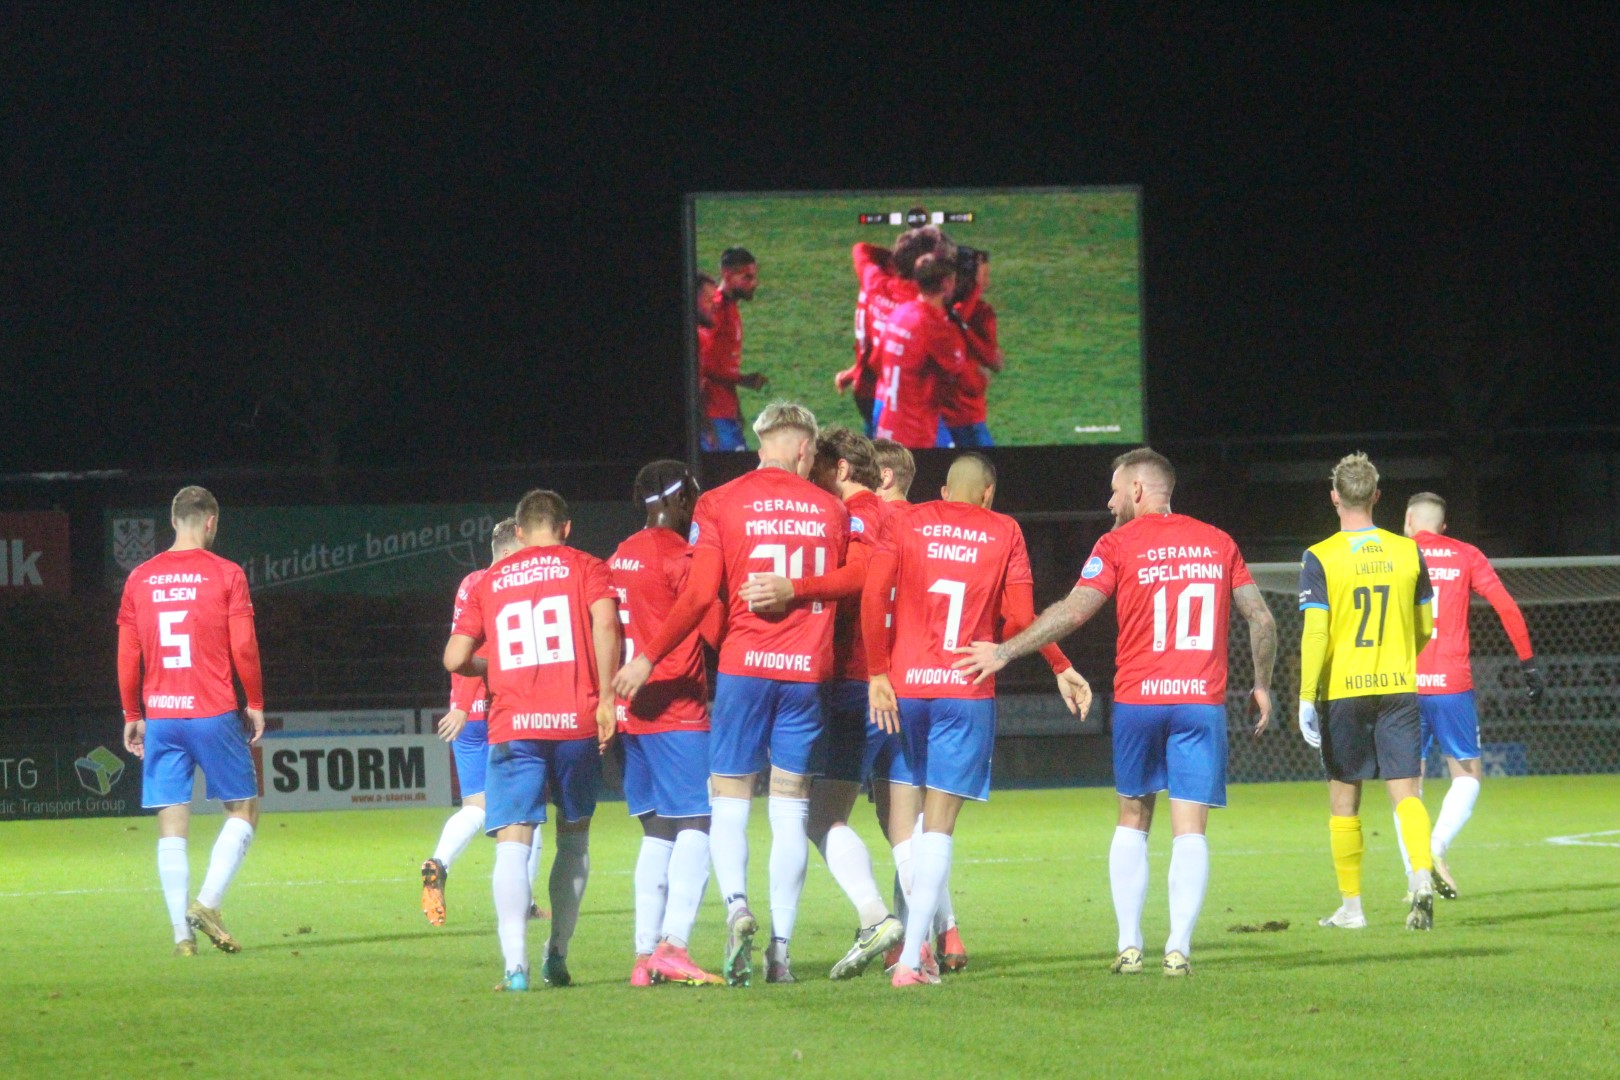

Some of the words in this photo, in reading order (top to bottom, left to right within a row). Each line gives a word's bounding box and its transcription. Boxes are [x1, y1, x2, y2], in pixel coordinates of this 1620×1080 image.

[746, 519, 826, 538] MAKIENOK
[265, 541, 357, 581] kridter
[366, 523, 450, 557] banen
[460, 514, 493, 542] op
[927, 542, 978, 563] SINGH
[1137, 563, 1223, 586] SPELMANN
[152, 587, 197, 603] OLSEN
[927, 578, 966, 651] 7
[1152, 582, 1216, 652] 10
[1353, 585, 1390, 648] 27
[158, 610, 192, 669] 5
[495, 594, 575, 671] 88
[744, 650, 812, 672] HVIDOVRE
[1141, 678, 1207, 696] HVIDOVRE
[1345, 673, 1388, 690] HOBRO
[1392, 672, 1407, 687] IK
[512, 712, 578, 731] HVIDOVRE
[272, 746, 426, 793] STORM
[20, 798, 81, 816] Transport
[86, 796, 126, 813] Group
